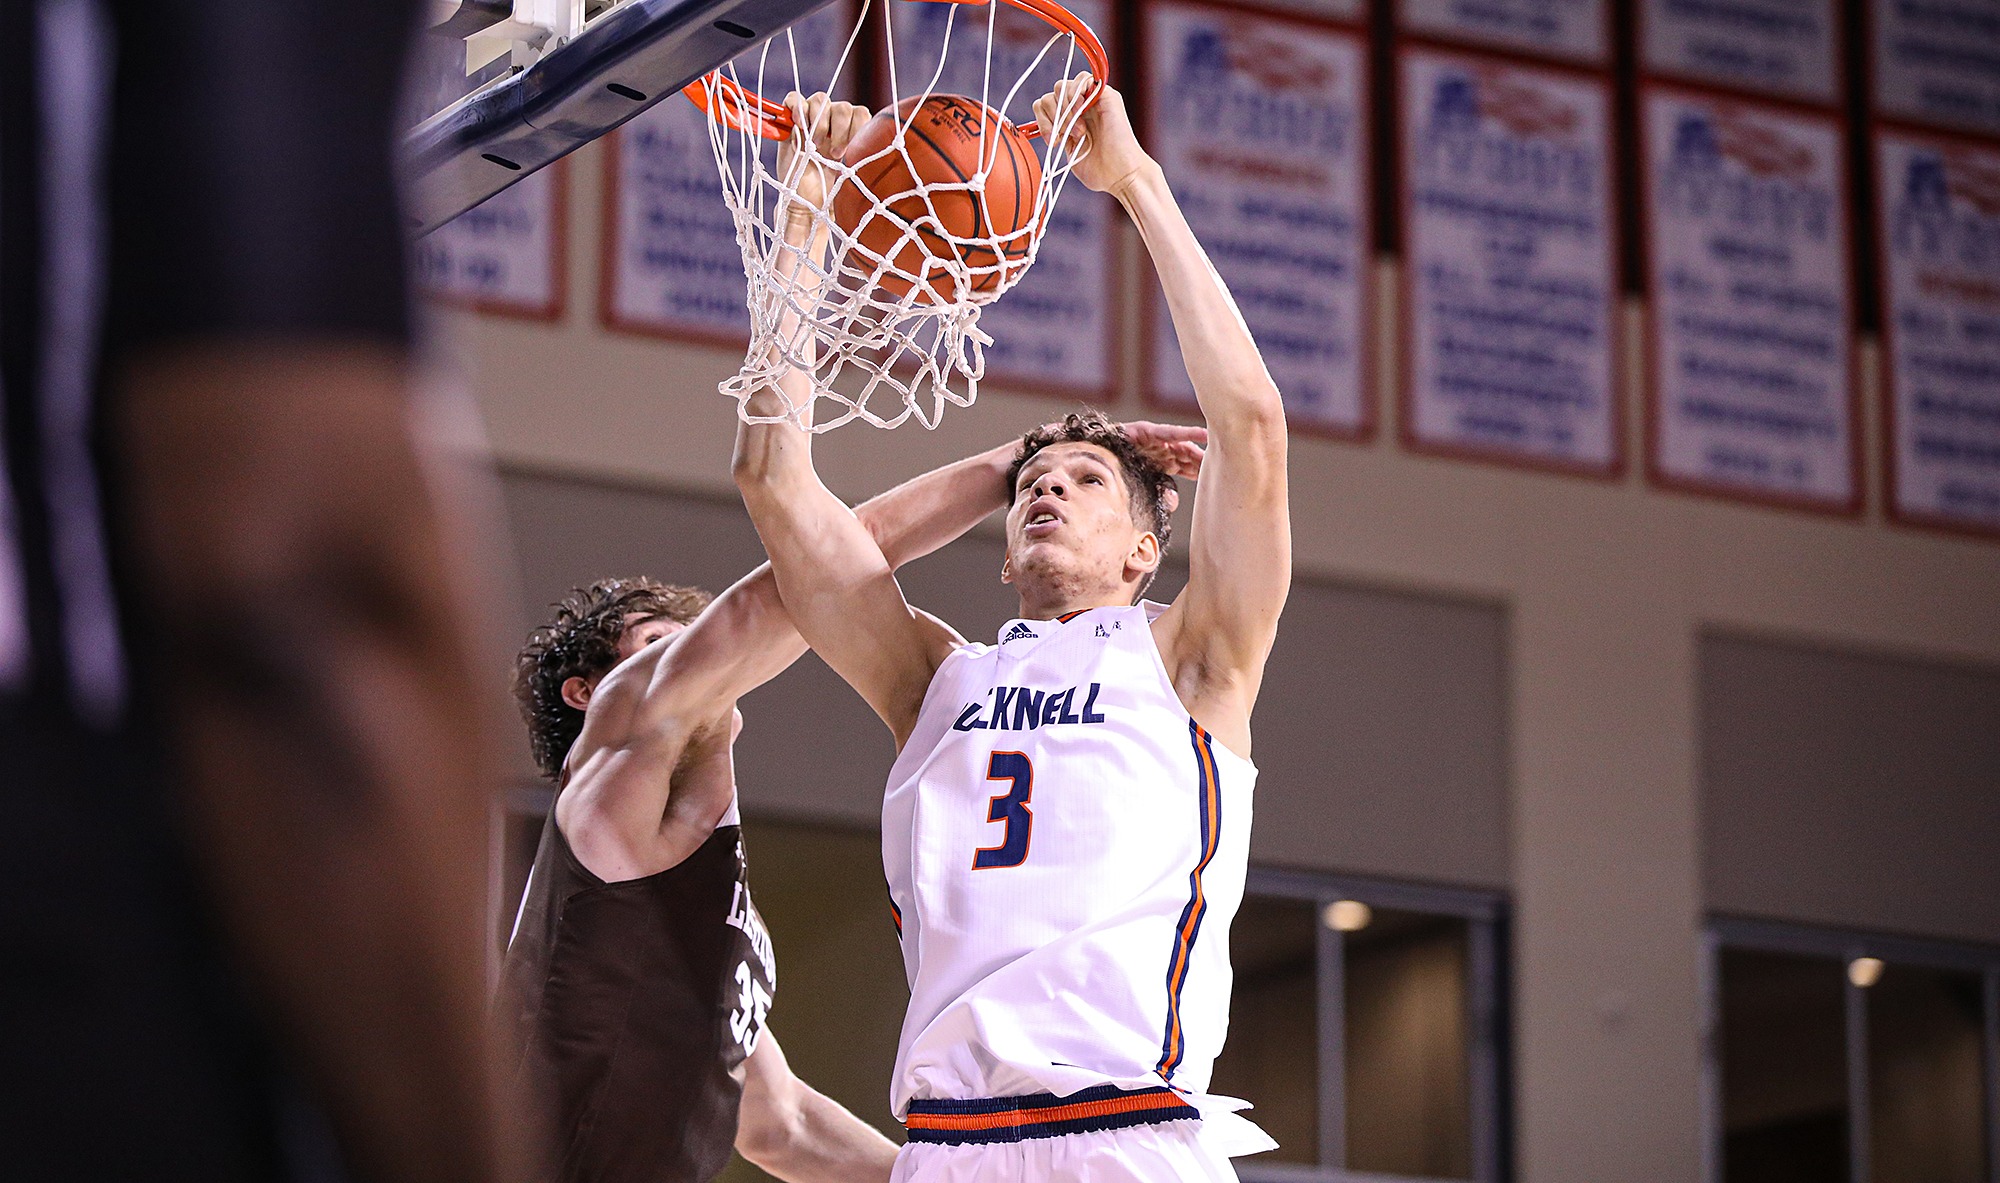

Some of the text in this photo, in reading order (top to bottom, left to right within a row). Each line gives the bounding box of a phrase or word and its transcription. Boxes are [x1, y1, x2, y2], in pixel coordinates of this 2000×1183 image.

[1002, 631, 1039, 645] adidas
[972, 750, 1034, 871] 3
[730, 960, 772, 1057] 35
